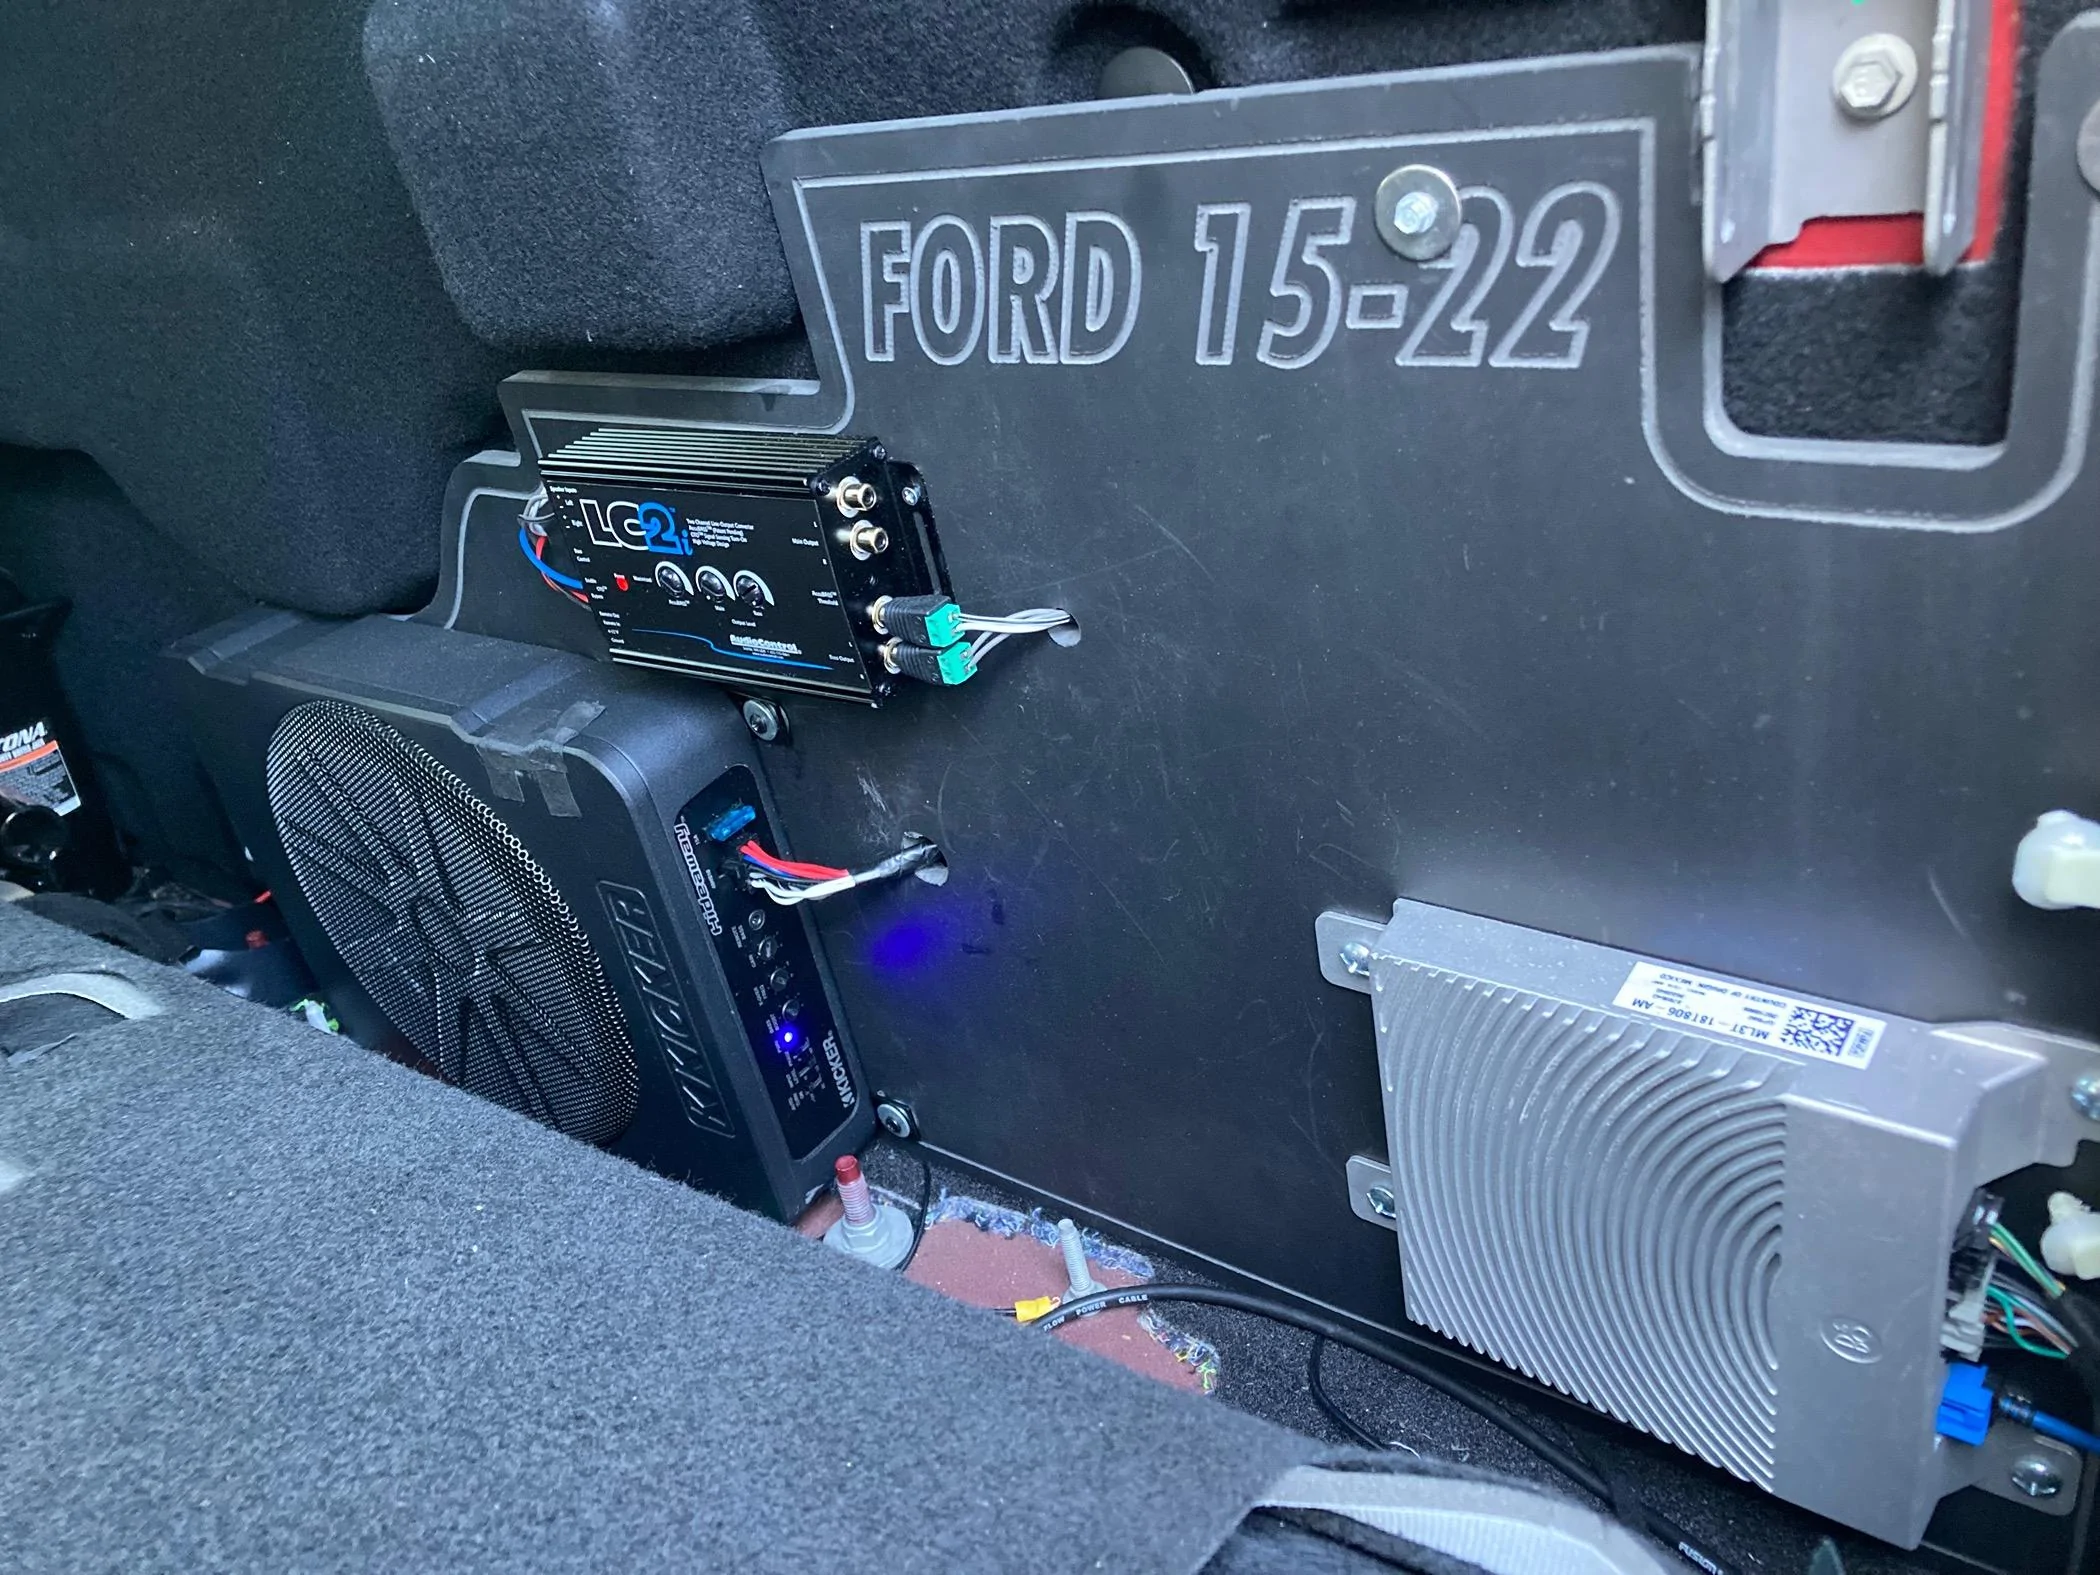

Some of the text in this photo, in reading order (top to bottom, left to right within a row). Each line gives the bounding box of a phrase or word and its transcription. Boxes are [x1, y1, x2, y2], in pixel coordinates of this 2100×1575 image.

[860, 180, 1621, 368] FORD 15-22
[674, 823, 723, 935] Hideaway
[822, 1033, 852, 1097] KICKER
[1076, 1302, 1107, 1316] POWER
[1118, 1293, 1148, 1304] CABLE
